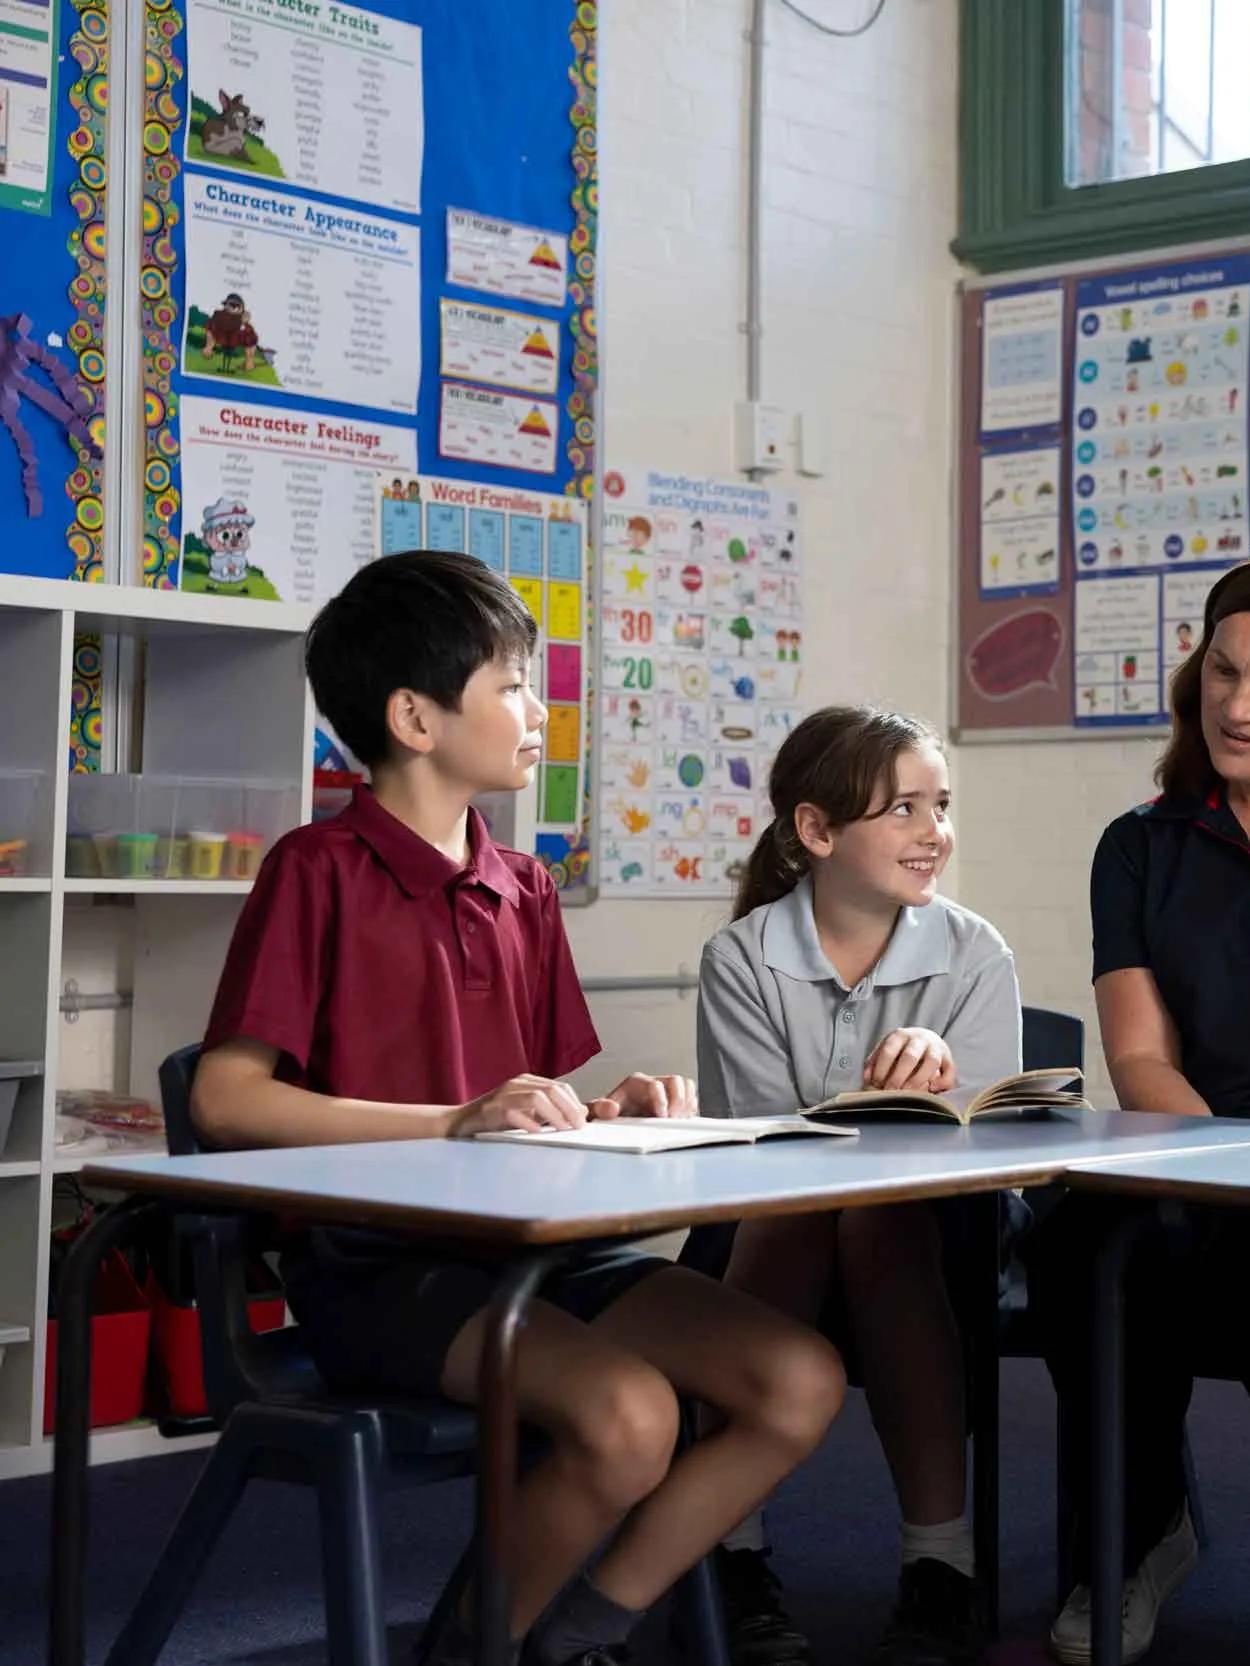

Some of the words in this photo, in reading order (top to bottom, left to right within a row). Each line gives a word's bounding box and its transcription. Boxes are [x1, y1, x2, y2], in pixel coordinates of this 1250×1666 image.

[329, 7, 379, 35] Traits
[194, 202, 218, 214] What
[222, 207, 242, 220] does
[245, 210, 260, 222] the
[263, 216, 304, 232] character
[309, 225, 326, 238] look
[206, 184, 296, 217] Character
[305, 207, 398, 242] Appearance
[1105, 282, 1137, 298] Vowel
[1139, 275, 1179, 294] spelling
[1181, 269, 1224, 286] choices
[199, 426, 218, 437] How
[224, 428, 242, 440] does
[247, 430, 261, 442] the
[263, 434, 305, 449] character
[220, 408, 308, 435] Character
[318, 422, 380, 449] Feelings
[432, 482, 476, 504] Word
[479, 489, 543, 515] Families
[648, 472, 700, 497] Blending
[648, 493, 674, 506] and
[677, 496, 727, 514] Digraphs
[621, 609, 652, 643] 30
[622, 656, 652, 690] 20
[662, 802, 683, 820] ng
